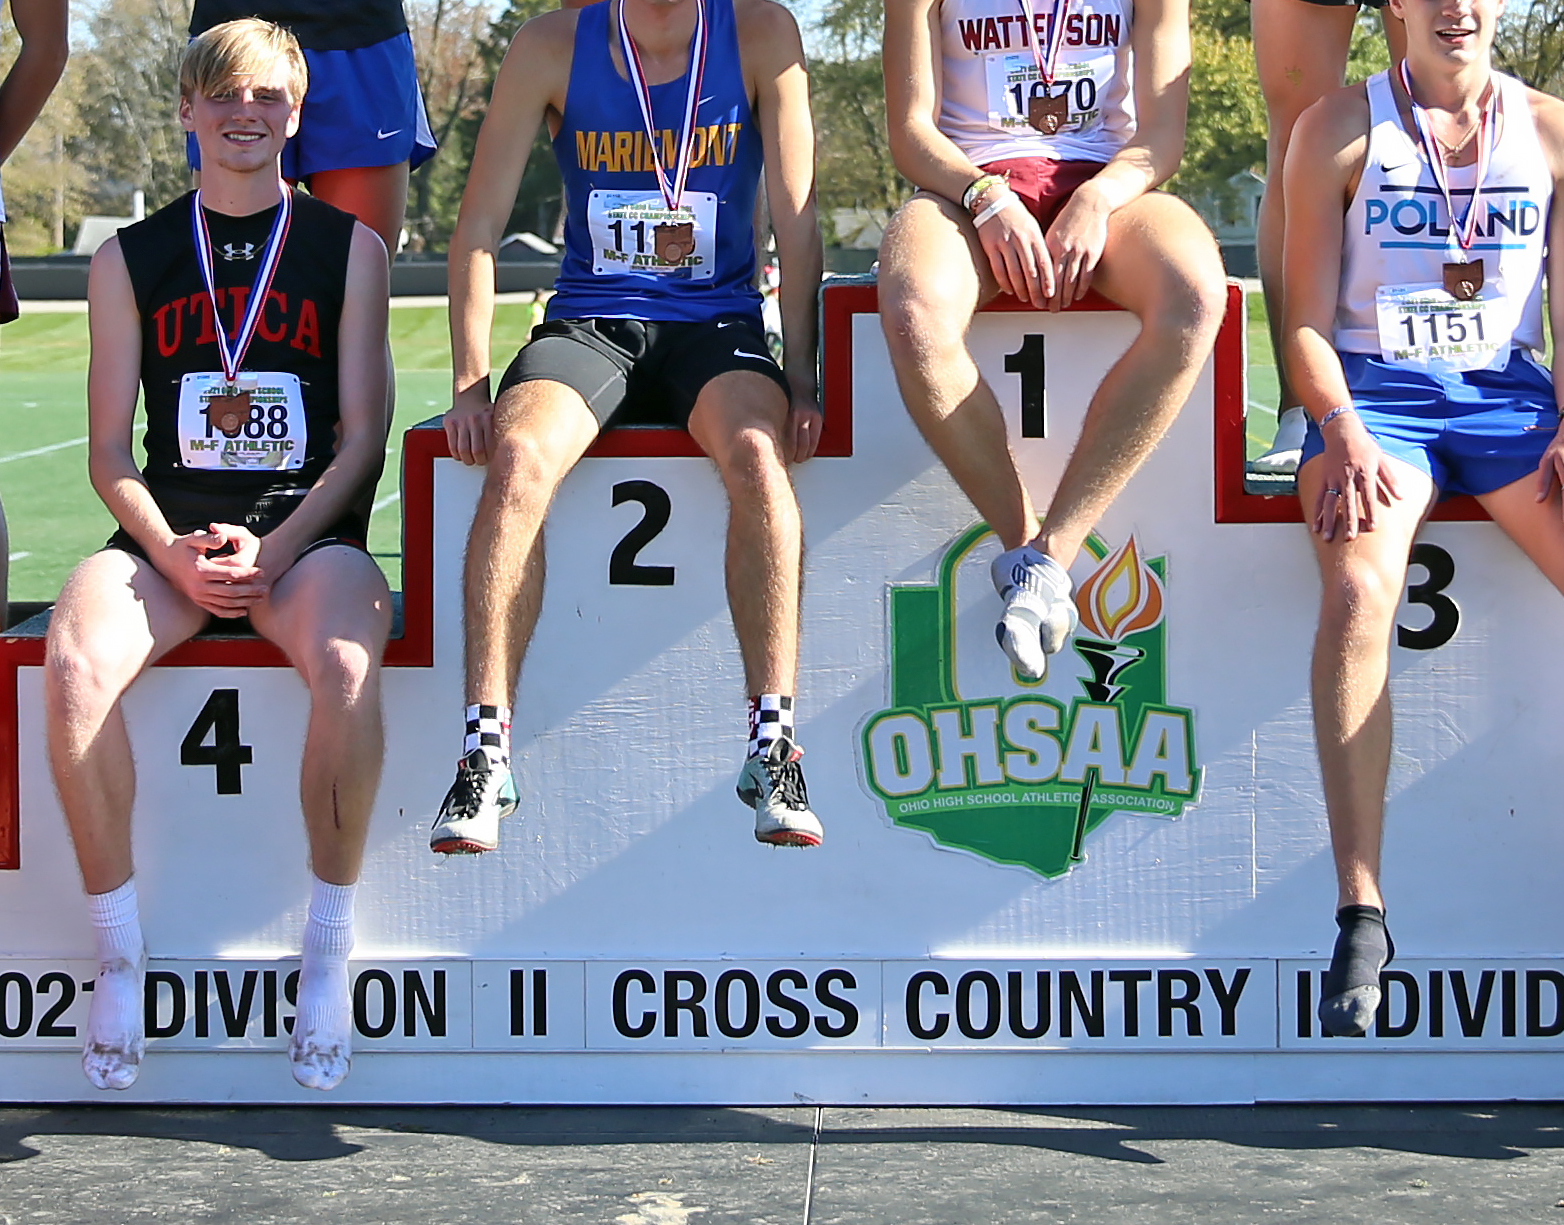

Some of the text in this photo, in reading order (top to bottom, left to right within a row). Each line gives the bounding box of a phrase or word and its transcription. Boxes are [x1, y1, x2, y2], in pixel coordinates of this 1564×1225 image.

[604, 249, 628, 263] M-F
[608, 220, 695, 255] 11
[153, 287, 322, 358] UTICA
[1400, 312, 1485, 346] 1151
[1394, 346, 1424, 361] M-F
[1004, 333, 1046, 438] 1
[190, 440, 295, 452] M-F ATHLETIC
[199, 405, 288, 439] 188
[610, 480, 675, 585] 2
[1397, 542, 1460, 650] 3
[180, 688, 253, 794] 4
[867, 700, 1194, 797] OHSAA
[899, 792, 1176, 814] OHIO HIGH SCHOOL ATHLETIC ASSOCIATION
[145, 970, 446, 1038] DIVION
[510, 969, 547, 1036] II
[613, 968, 859, 1039] CROSS
[905, 968, 1252, 1040] COUNTRY
